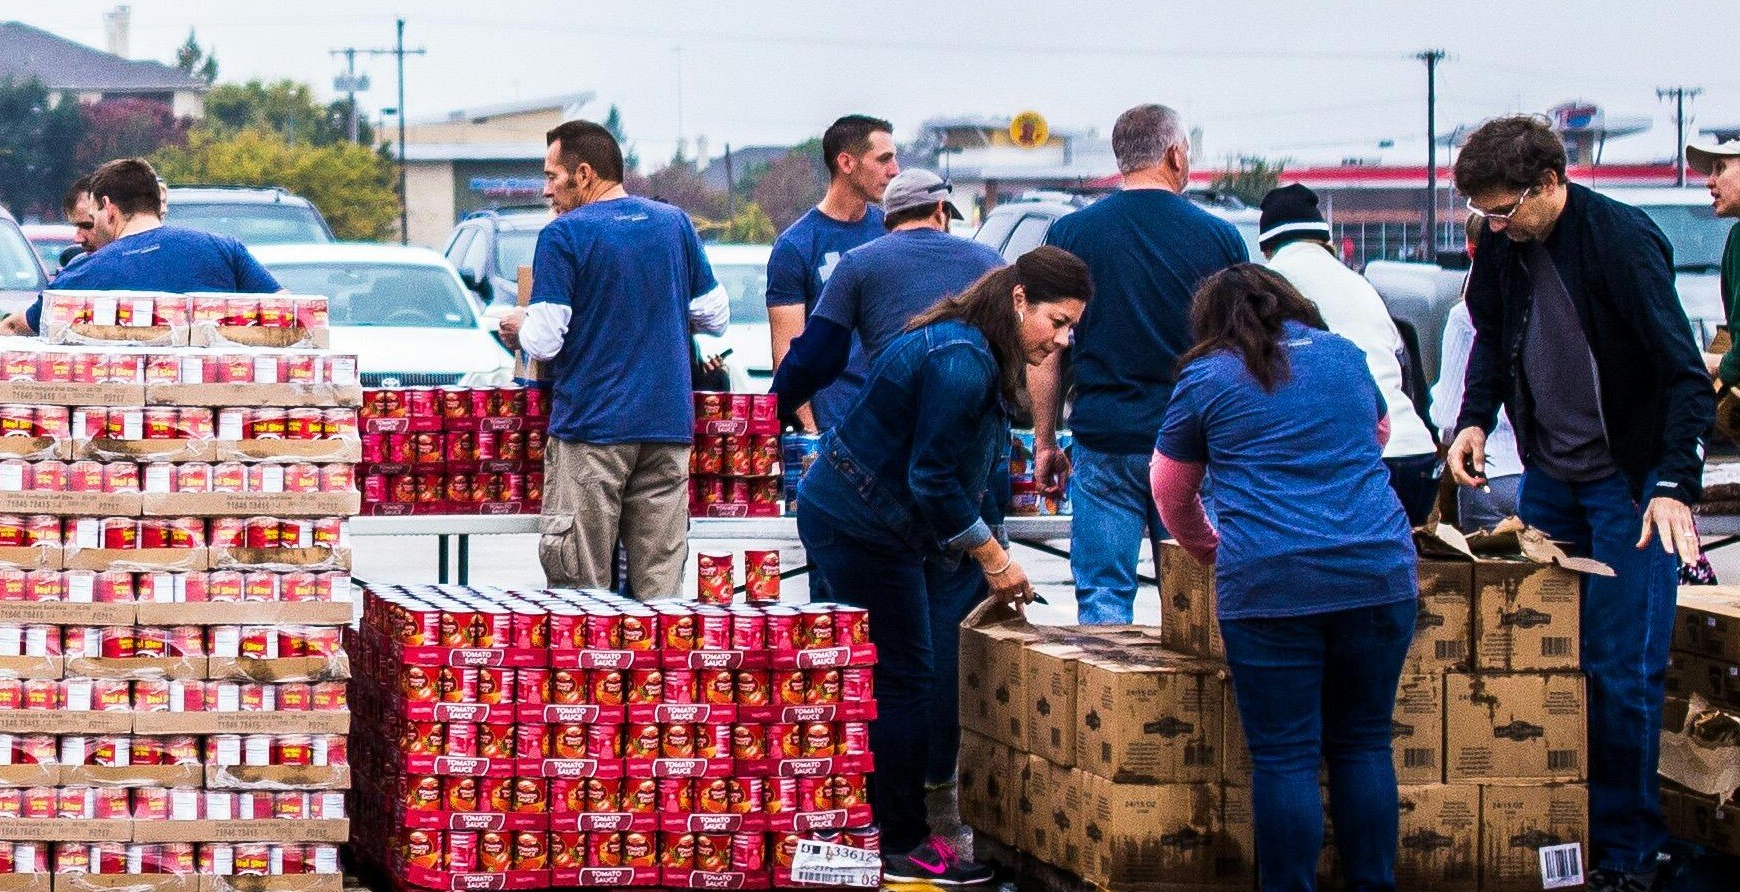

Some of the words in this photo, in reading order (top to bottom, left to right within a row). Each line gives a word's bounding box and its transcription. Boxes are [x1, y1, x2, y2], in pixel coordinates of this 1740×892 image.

[809, 650, 838, 659] TOMATO
[812, 657, 835, 665] SAUCE
[794, 708, 824, 716] TOMATO
[462, 815, 492, 823] TOMATO
[590, 815, 620, 823] TOMATO
[806, 813, 836, 822] TOMATO
[809, 819, 833, 827] SAUCE
[463, 875, 493, 883] TOMATO
[595, 876, 617, 884] SAUCE
[467, 881, 489, 889] SAUCE
